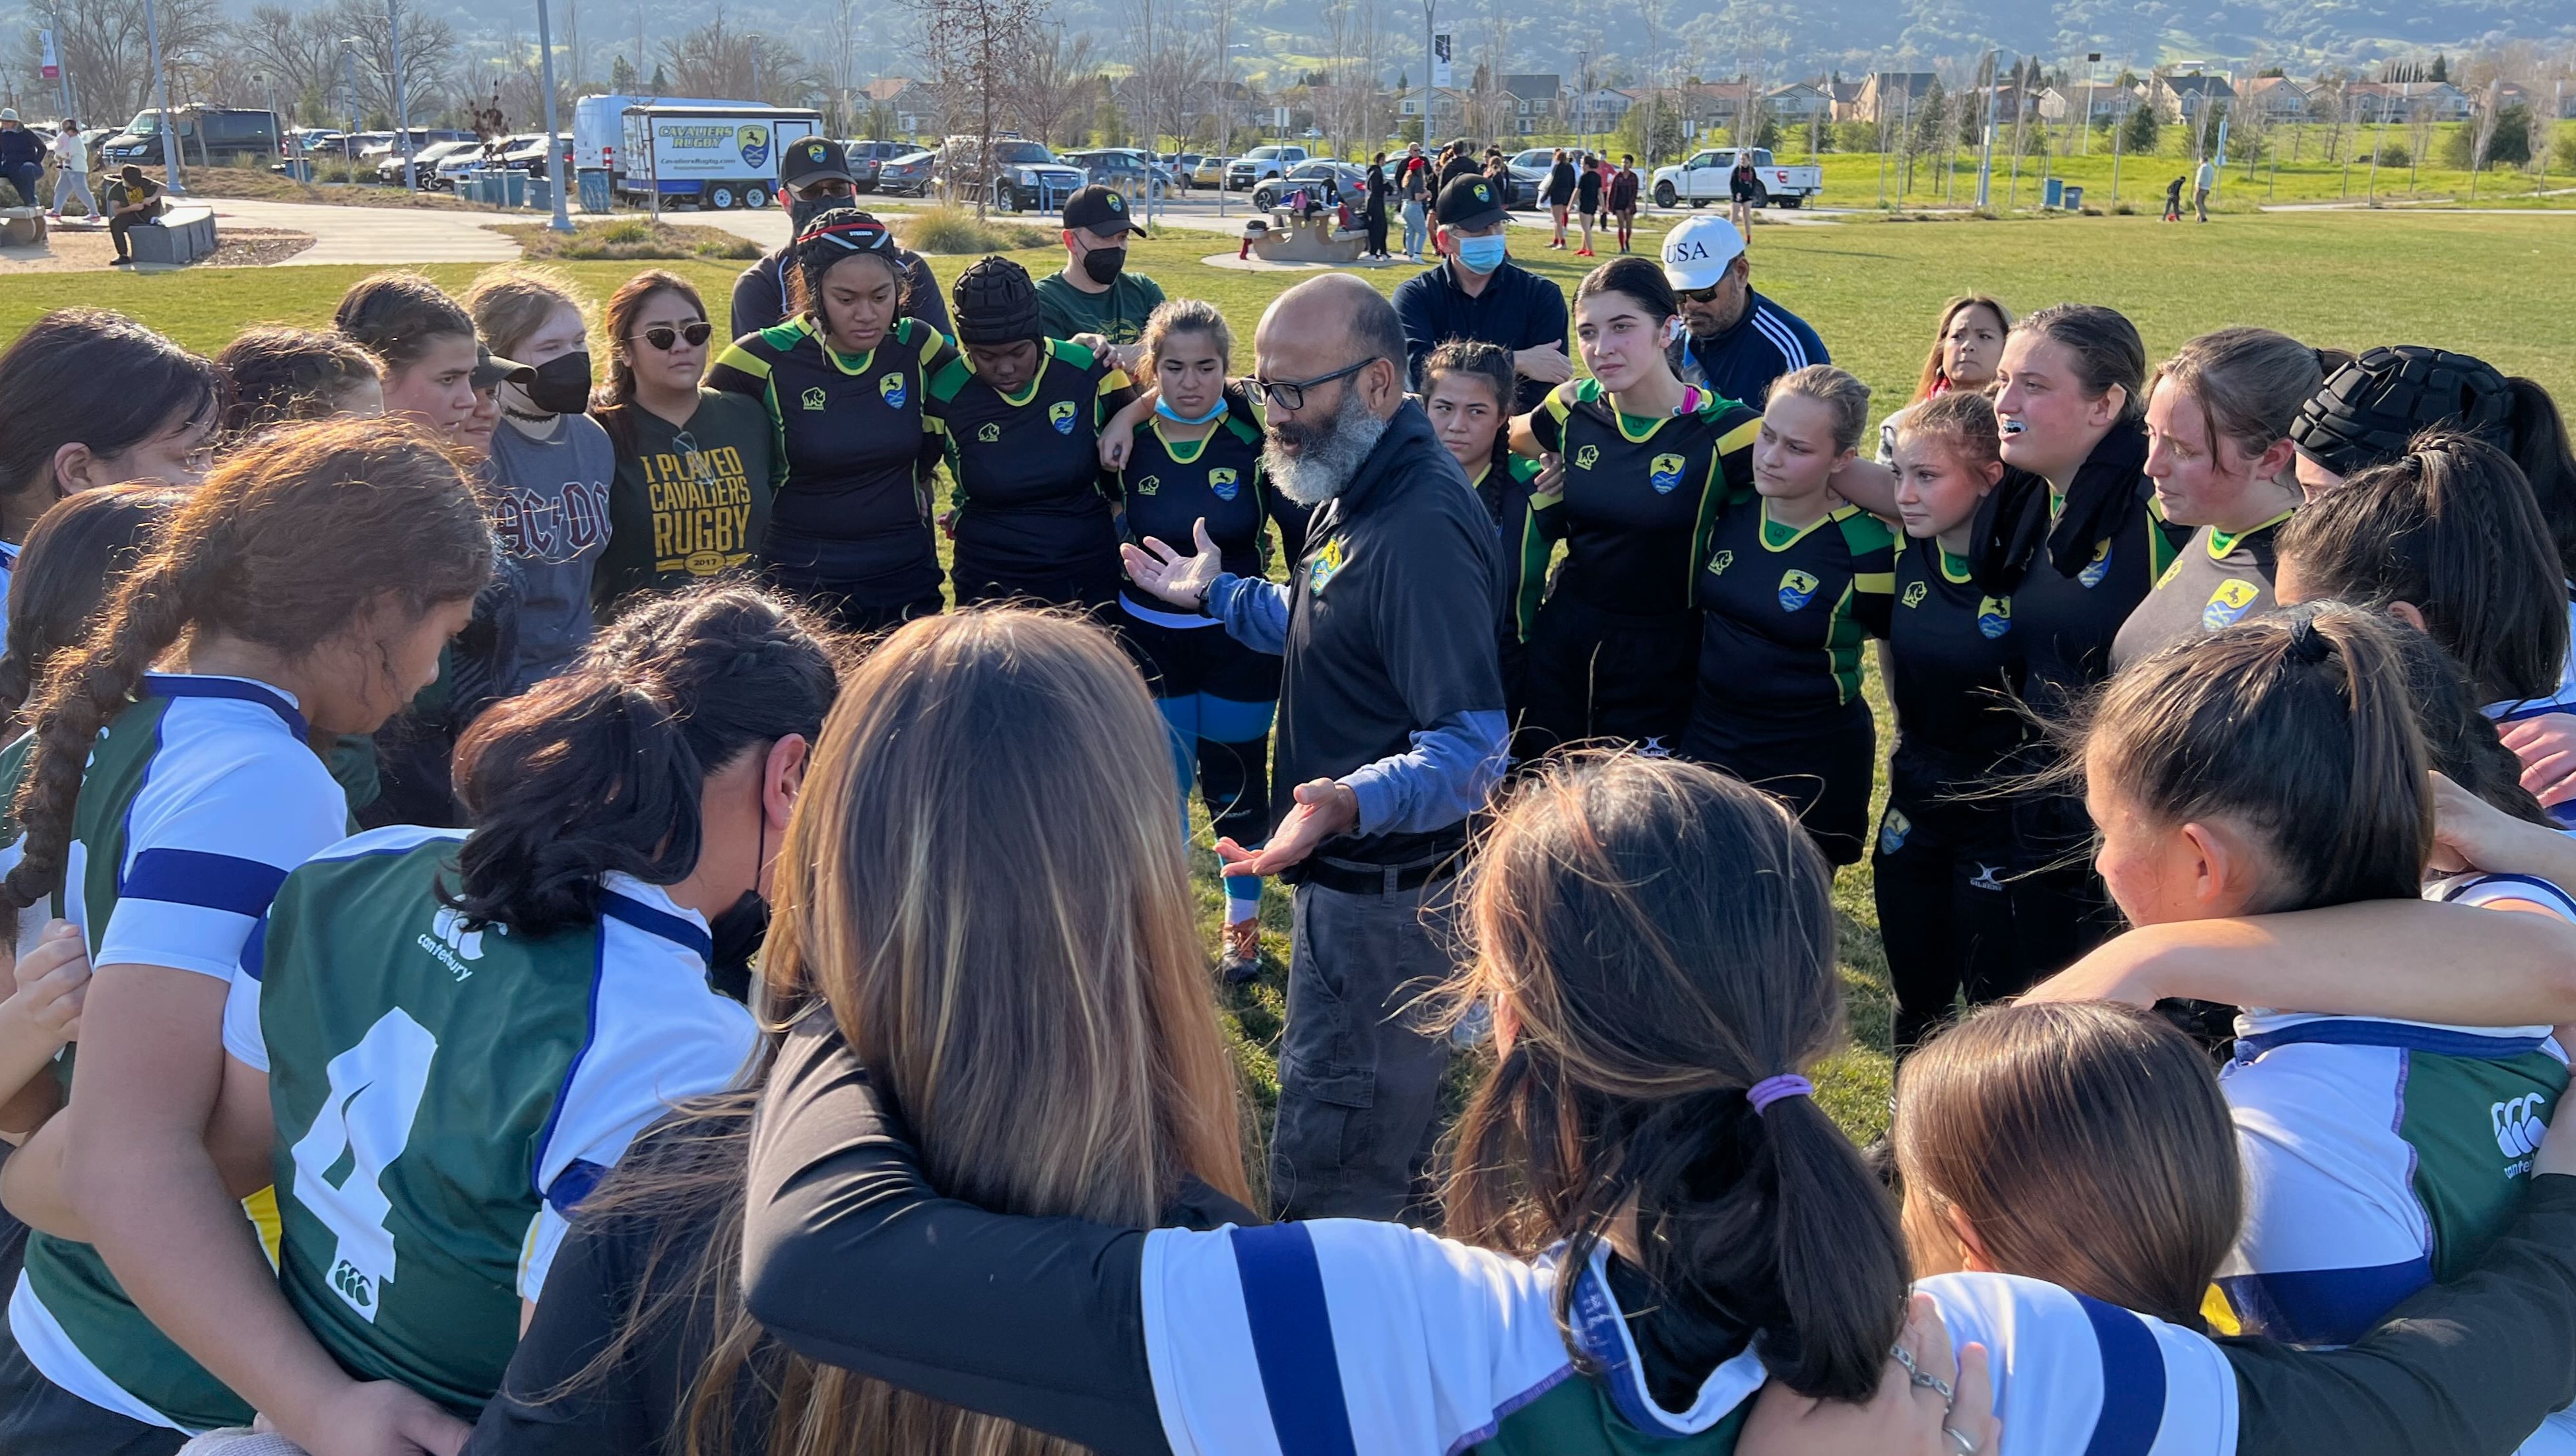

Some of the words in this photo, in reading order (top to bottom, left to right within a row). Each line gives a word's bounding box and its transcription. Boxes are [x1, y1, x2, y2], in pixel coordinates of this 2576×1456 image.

[659, 126, 734, 137] CAVALIERS
[672, 137, 724, 149] RUGBY
[1666, 241, 1710, 263] USA
[640, 456, 656, 483] I
[656, 446, 744, 482] PLAYED
[649, 476, 751, 512] CAVALIERS
[653, 504, 751, 558] RUGBY
[417, 933, 473, 982] canterbury
[290, 1006, 437, 1324] 4
